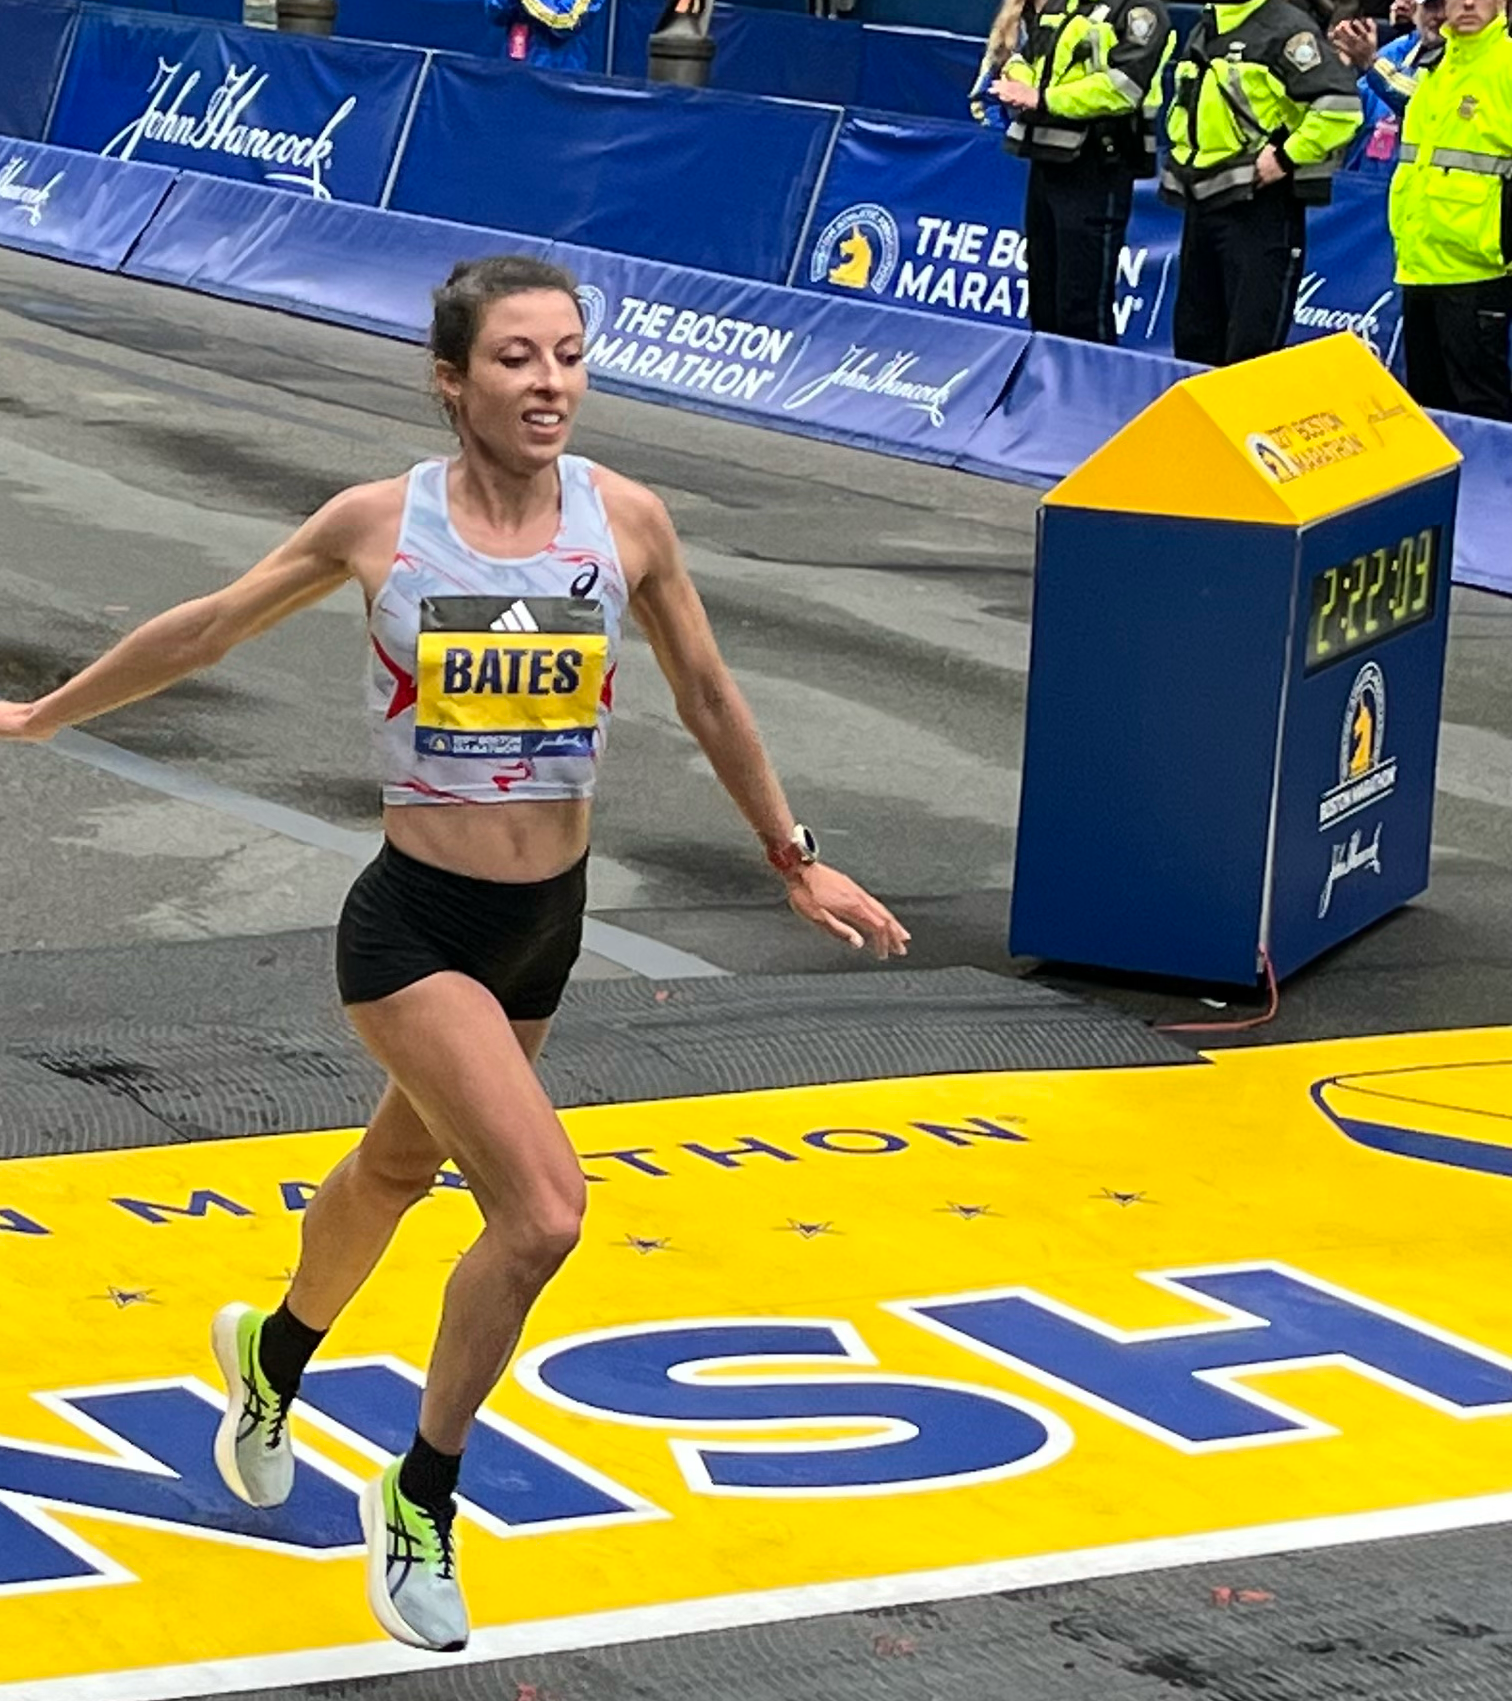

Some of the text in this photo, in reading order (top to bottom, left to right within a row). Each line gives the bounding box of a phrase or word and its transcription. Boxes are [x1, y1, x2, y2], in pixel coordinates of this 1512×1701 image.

[99, 56, 357, 202] John Hancock
[915, 216, 989, 264] THE
[612, 296, 675, 339] THE
[666, 309, 794, 365] BOSTON
[582, 332, 771, 400] MARATHON
[1316, 529, 1432, 655] 2:22:09
[443, 647, 584, 695] BATES
